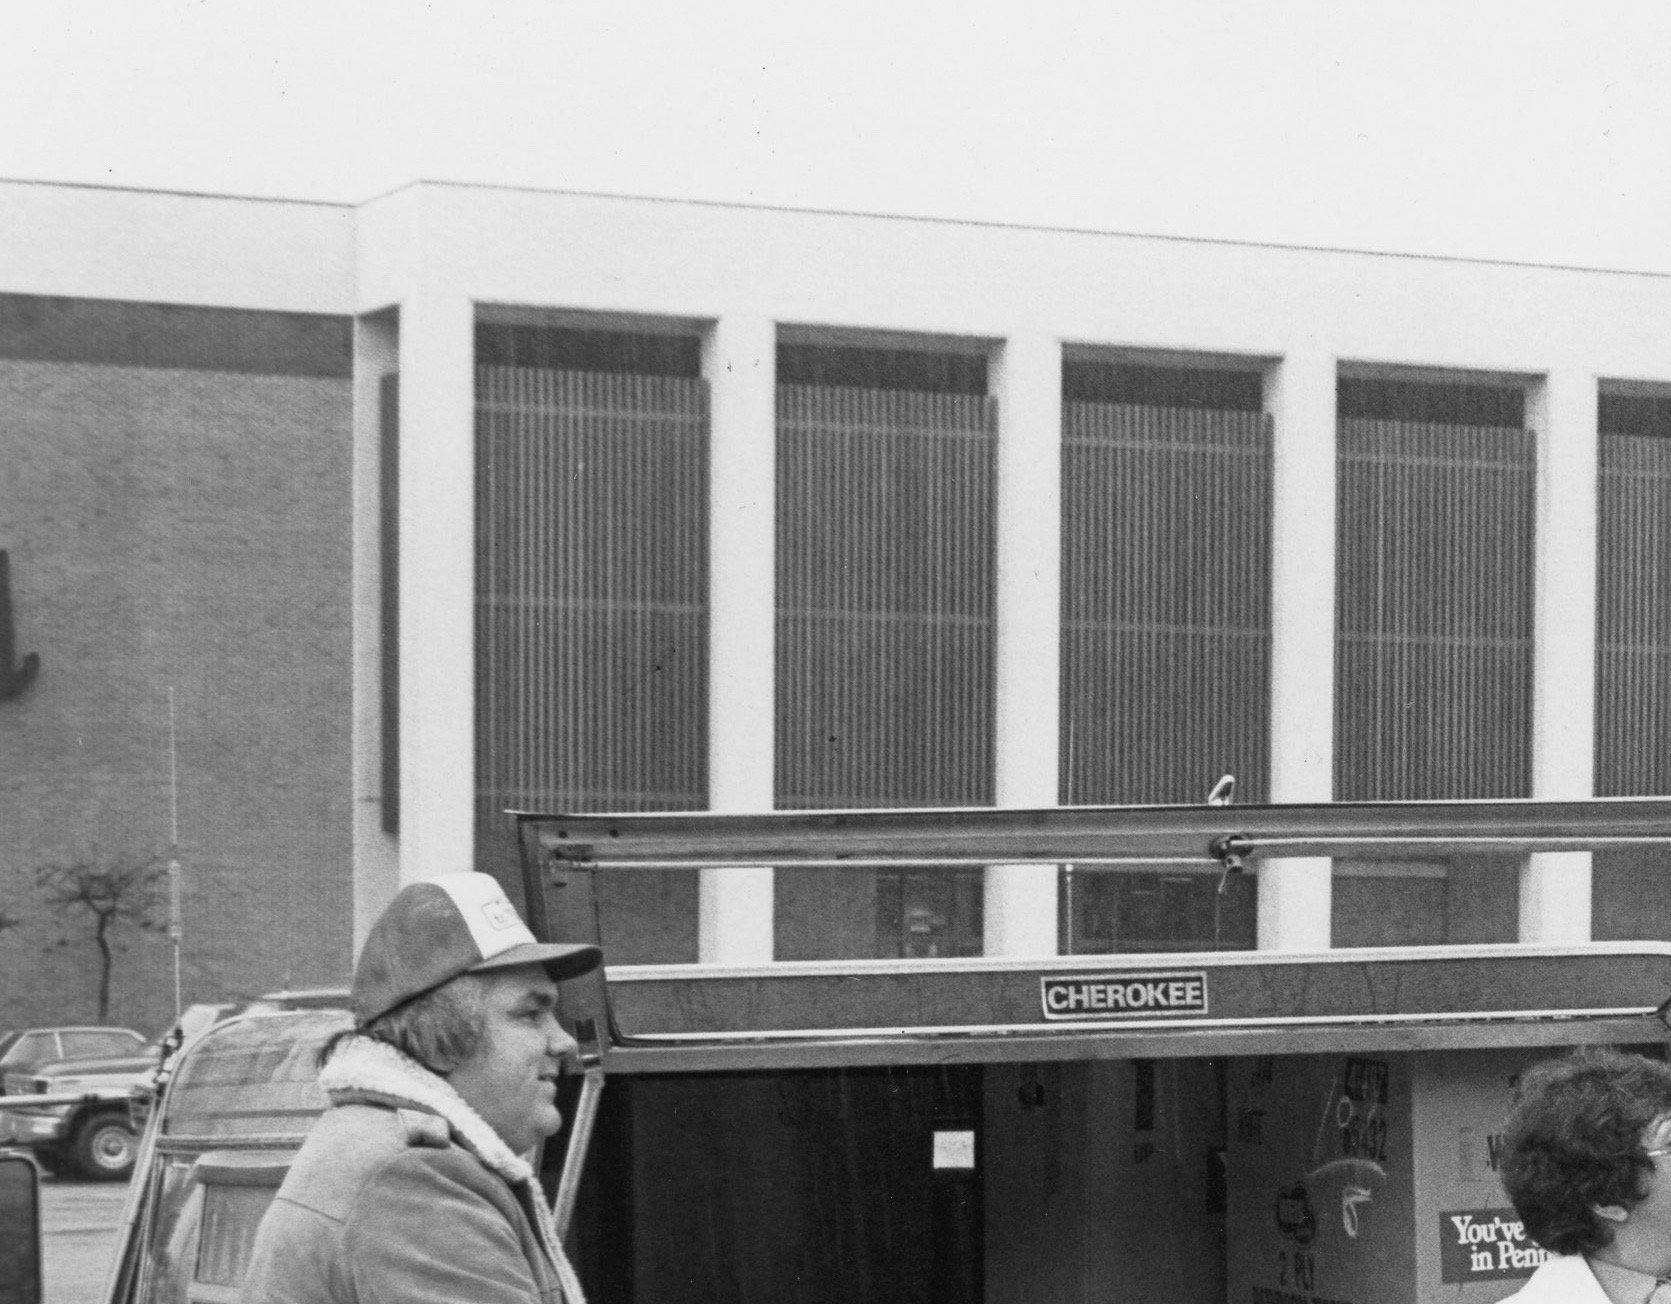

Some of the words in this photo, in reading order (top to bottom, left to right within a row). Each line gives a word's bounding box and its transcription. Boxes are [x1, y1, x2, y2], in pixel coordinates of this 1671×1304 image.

[1049, 981, 1202, 1010] CHEROKEE
[1450, 1214, 1526, 1245] You've
[1471, 1245, 1494, 1272] in
